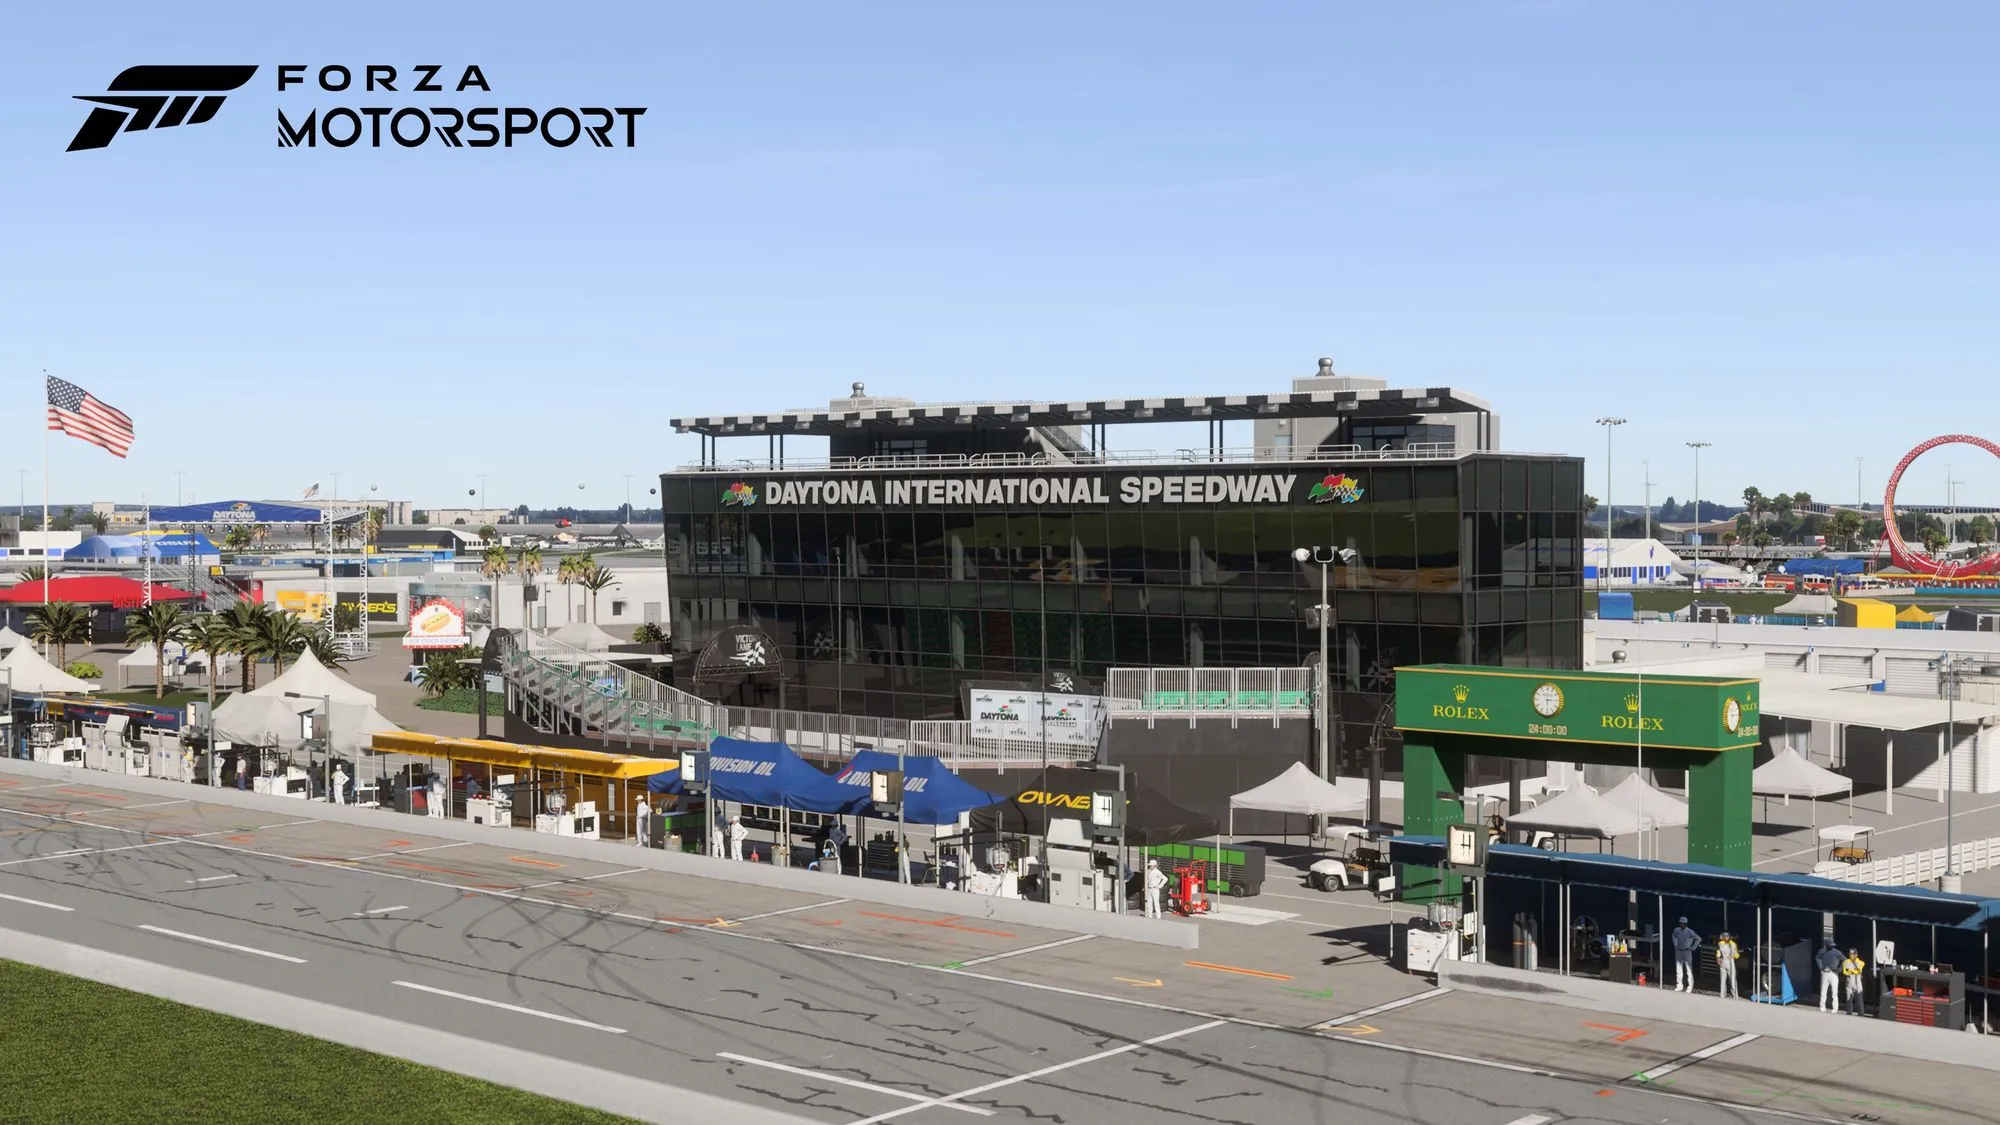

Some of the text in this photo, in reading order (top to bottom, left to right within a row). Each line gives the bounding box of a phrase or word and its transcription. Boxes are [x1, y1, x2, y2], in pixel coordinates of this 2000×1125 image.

[765, 474, 1297, 505] DAYTONA INTERNATIONAL SPEEDWAY
[212, 510, 256, 519] DAYTONA
[735, 642, 752, 652] LANE
[980, 712, 1018, 720] DAYTONA
[1433, 705, 1490, 720] ROLEX
[1528, 724, 1568, 736] 24:00:00
[1601, 716, 1664, 731] ROLEX
[710, 757, 776, 776] DIVISION OIL
[904, 777, 928, 793] OIL
